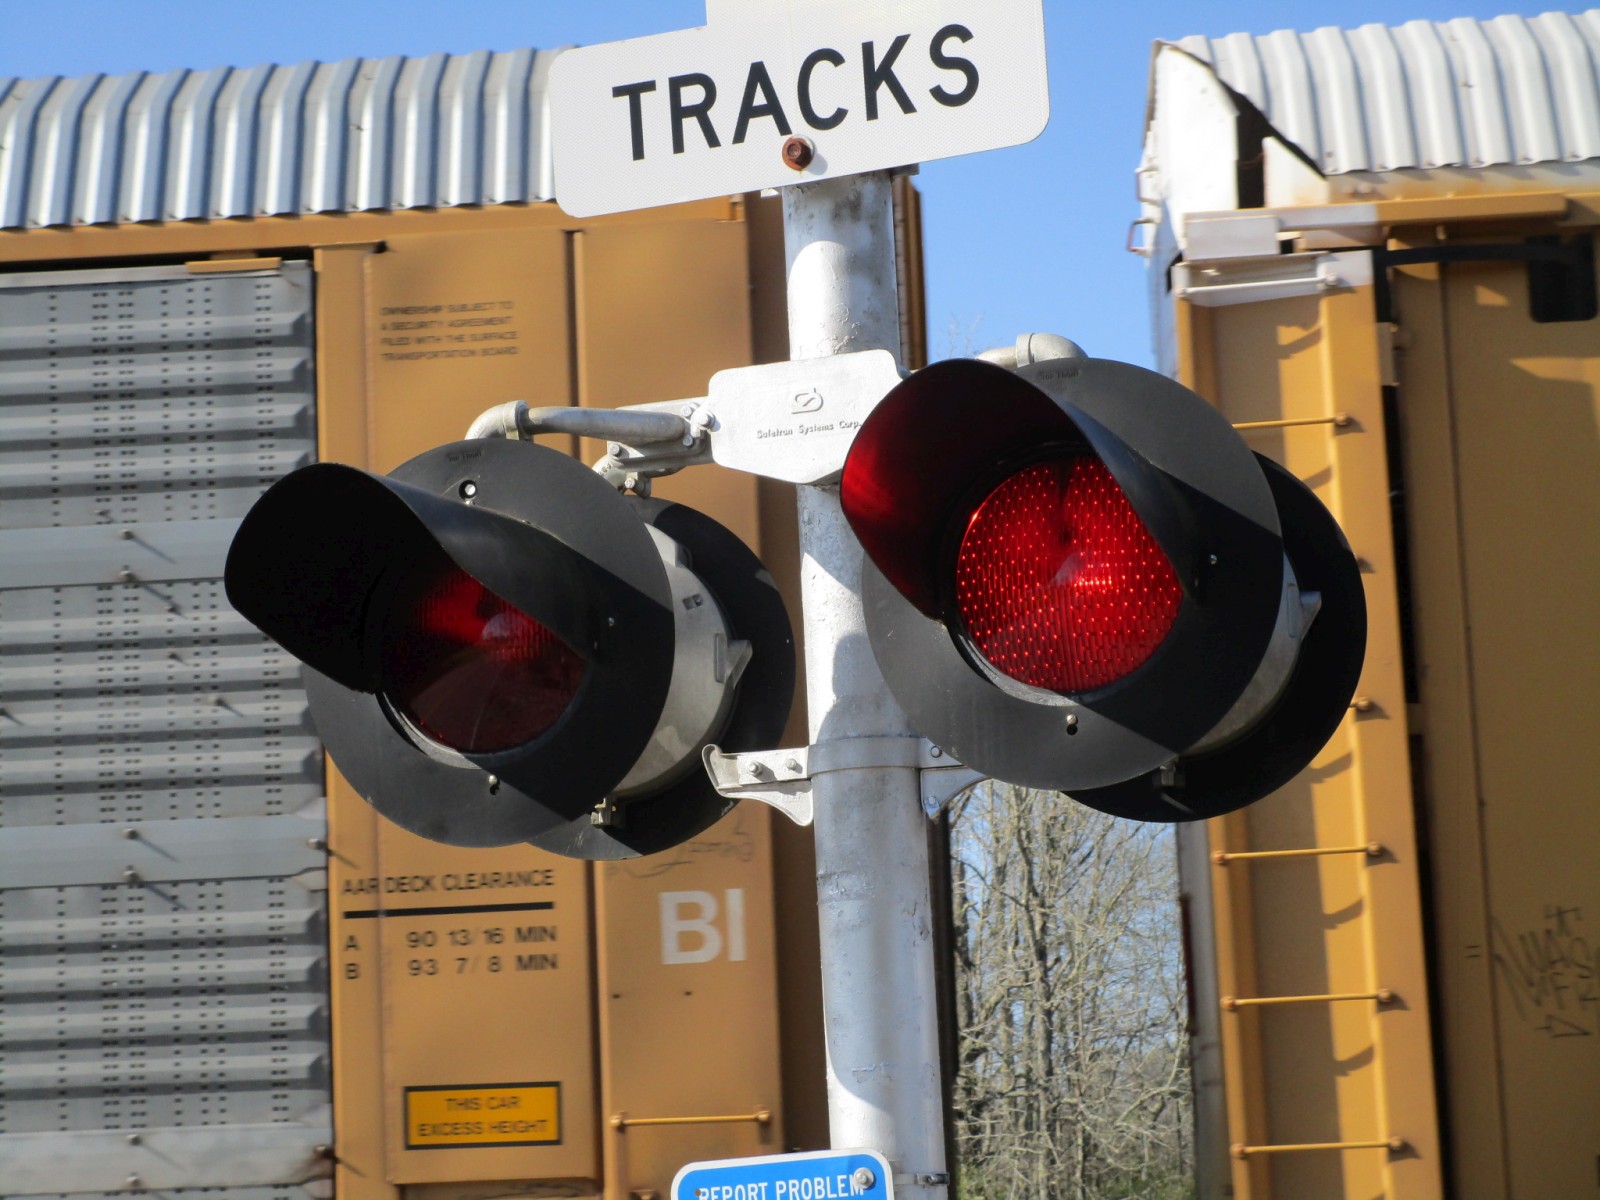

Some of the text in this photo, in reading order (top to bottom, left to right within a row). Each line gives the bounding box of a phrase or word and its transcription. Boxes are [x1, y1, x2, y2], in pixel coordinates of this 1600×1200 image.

[612, 24, 980, 161] TRACKS
[342, 869, 554, 896] AAR DECK CLEARANCE
[344, 934, 360, 952] A
[406, 930, 437, 949] 90
[514, 925, 557, 944] MIN
[659, 888, 747, 965] BI
[345, 962, 360, 981] B
[408, 957, 438, 976] 93
[515, 953, 558, 972] MIN
[446, 1095, 521, 1112] THIS CAR
[418, 1119, 548, 1137] EXCESS HEIGHT
[775, 1173, 864, 1200] PROBLEM
